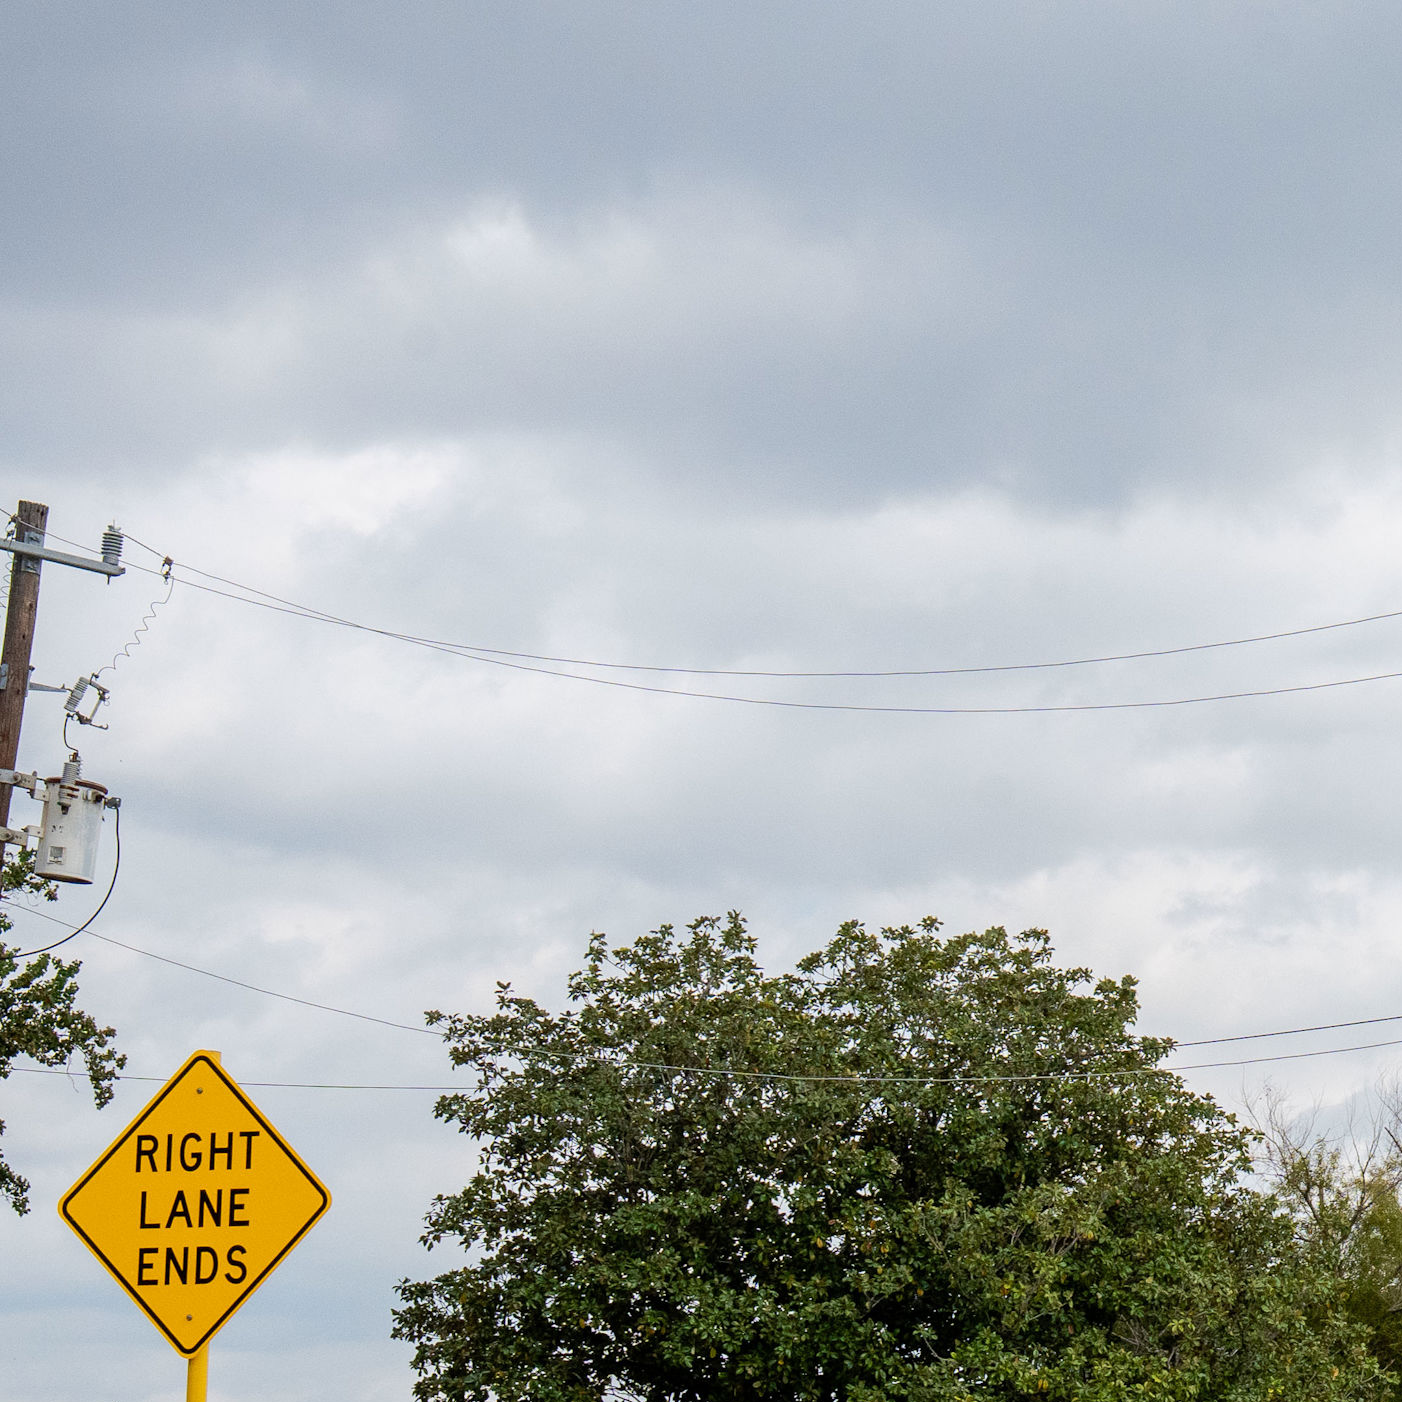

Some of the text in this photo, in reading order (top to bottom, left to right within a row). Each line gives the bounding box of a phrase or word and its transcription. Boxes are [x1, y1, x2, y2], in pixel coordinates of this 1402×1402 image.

[135, 1131, 260, 1173] RIGHT
[139, 1188, 250, 1229] LANE
[137, 1244, 248, 1286] ENDS
